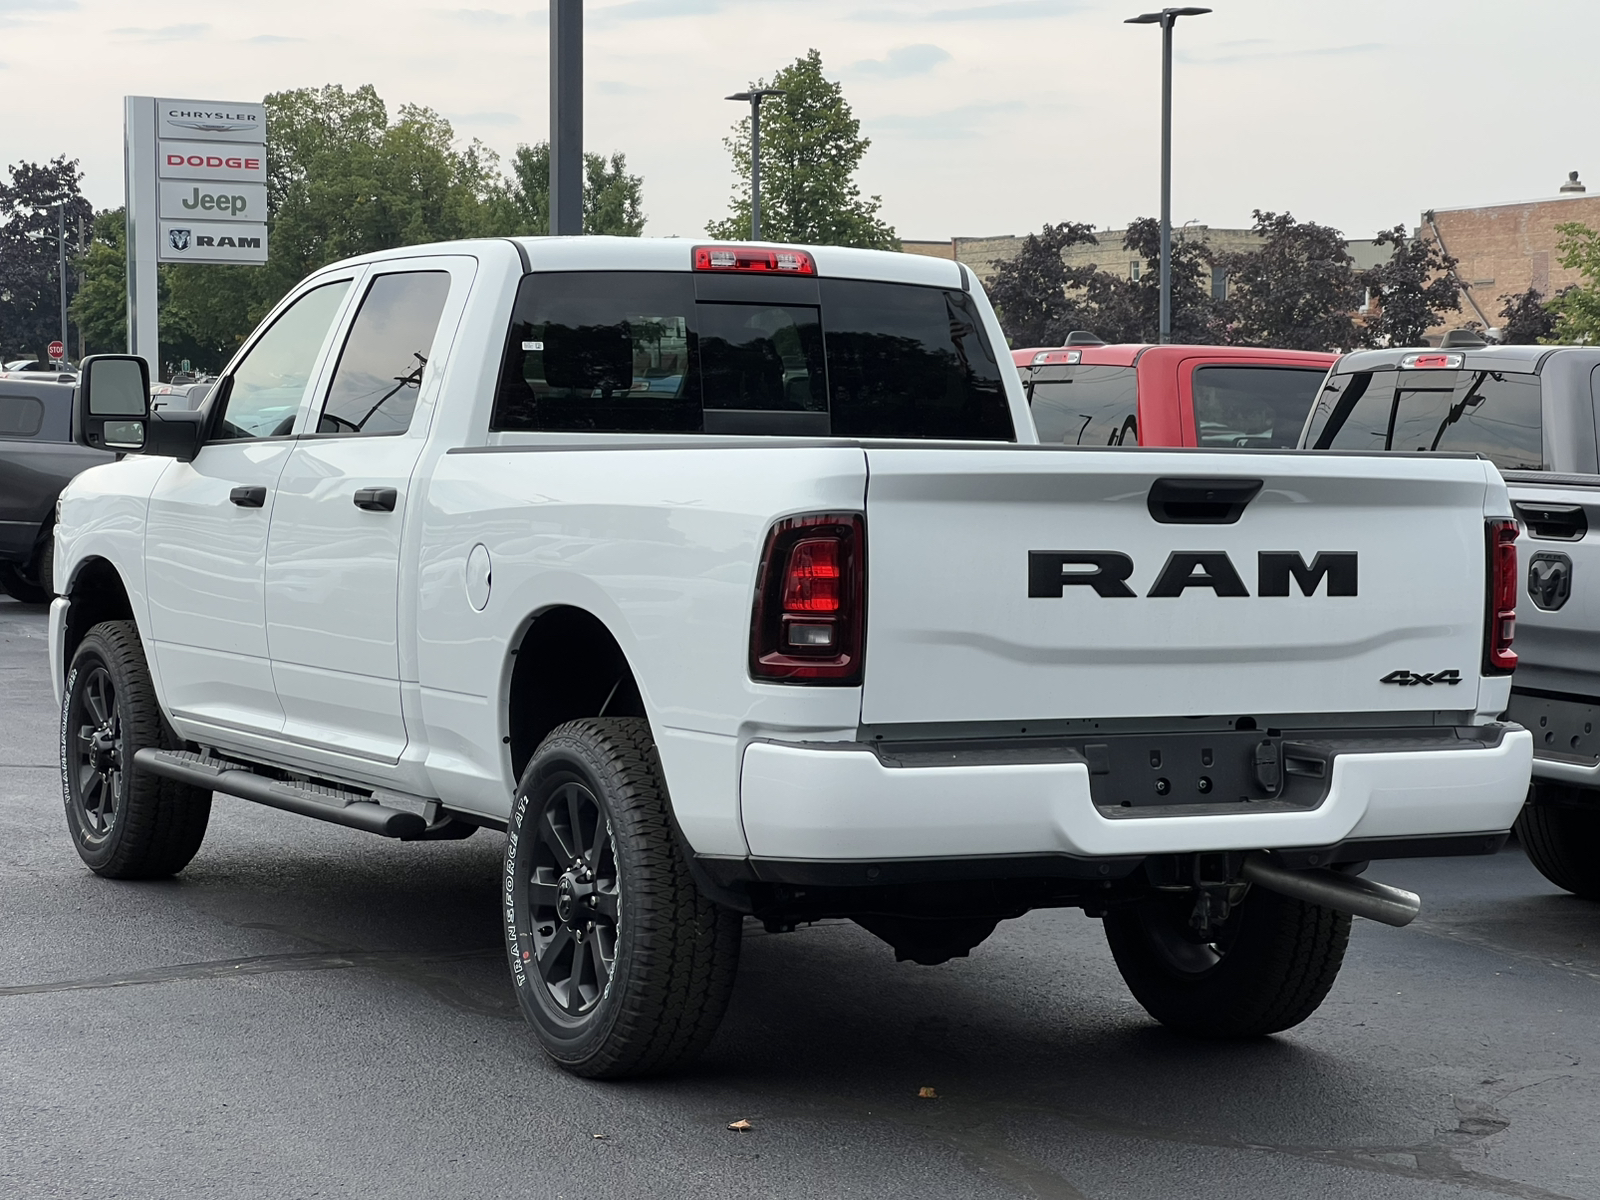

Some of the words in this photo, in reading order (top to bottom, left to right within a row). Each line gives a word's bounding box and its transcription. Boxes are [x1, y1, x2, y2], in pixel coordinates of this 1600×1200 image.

[168, 110, 257, 121] CHRYSLER
[166, 154, 260, 170] DODGE
[182, 187, 247, 216] Jeep
[196, 235, 261, 248] RAM
[1027, 550, 1359, 598] RAM
[1380, 669, 1463, 686] 4x4
[505, 831, 526, 987] TRANSFORCE
